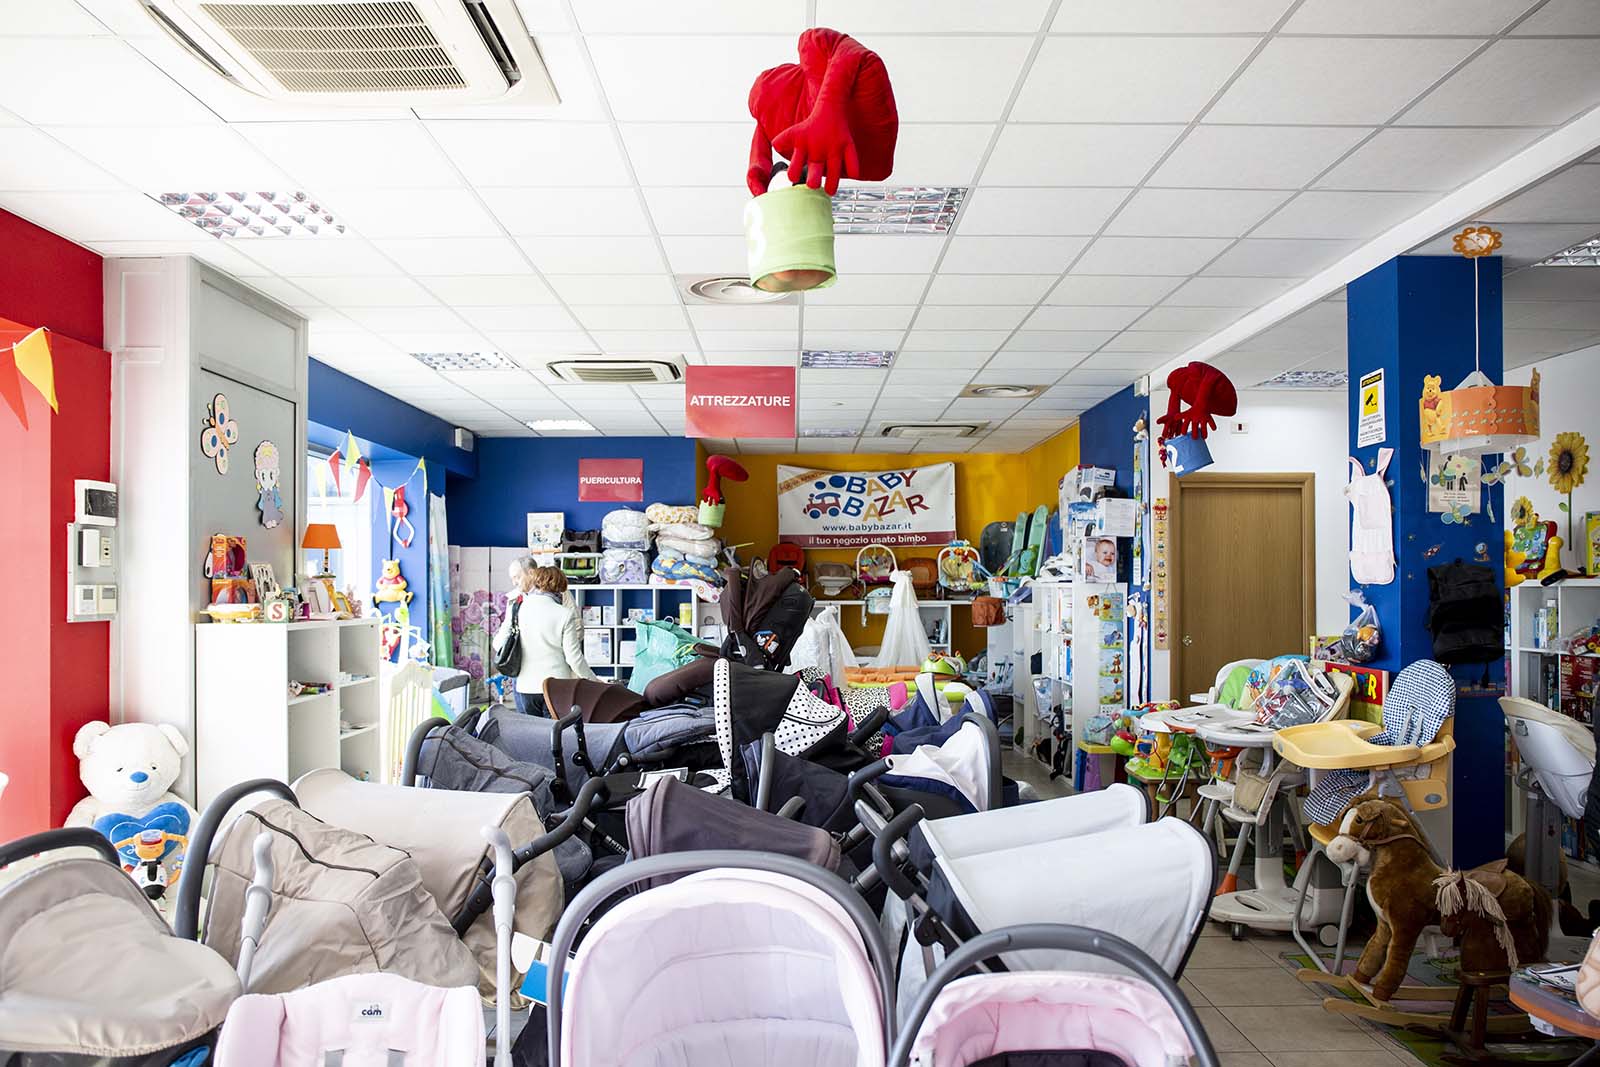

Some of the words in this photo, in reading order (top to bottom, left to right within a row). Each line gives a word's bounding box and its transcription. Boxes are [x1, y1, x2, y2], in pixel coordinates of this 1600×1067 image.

[690, 395, 790, 406] ATTREZZATURE
[580, 476, 642, 485] PUERICULTURA
[846, 470, 918, 496] BABY
[842, 490, 929, 521] BAZAR
[822, 522, 912, 532] www.babybazar.it
[808, 536, 814, 544] il
[816, 536, 831, 544] tuo
[833, 535, 869, 545] negozio
[871, 536, 896, 544] usato
[272, 603, 283, 620] S
